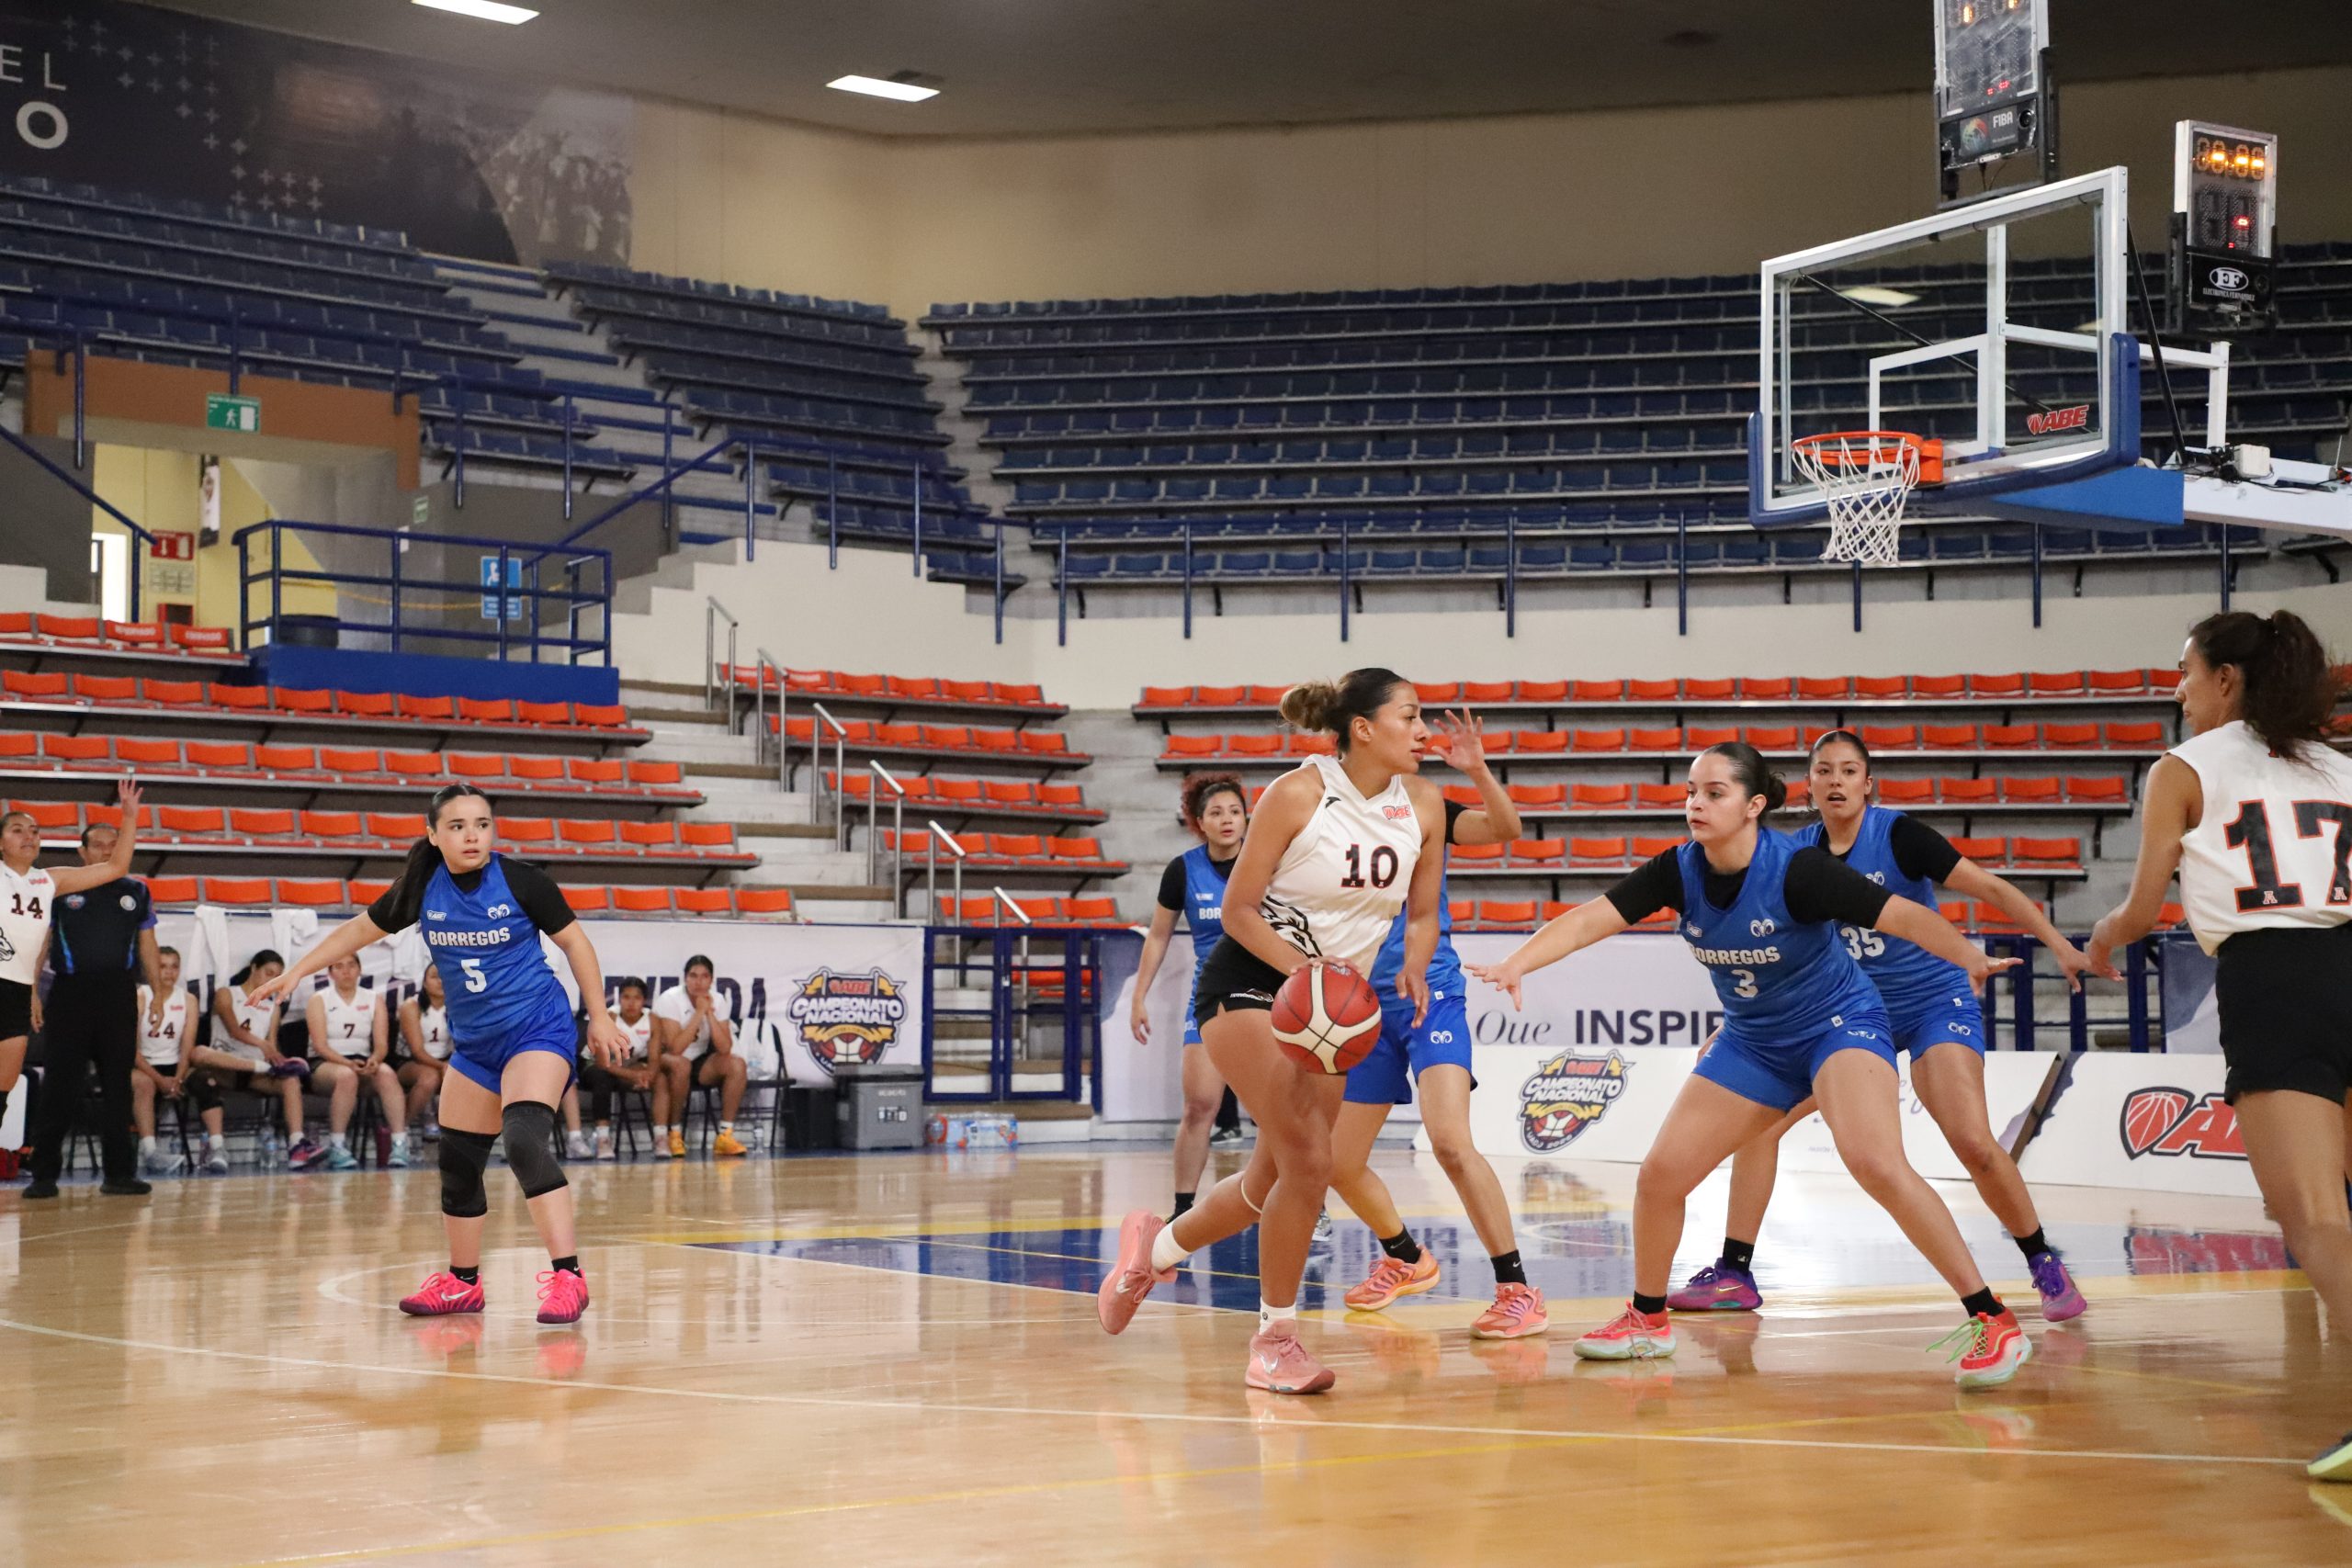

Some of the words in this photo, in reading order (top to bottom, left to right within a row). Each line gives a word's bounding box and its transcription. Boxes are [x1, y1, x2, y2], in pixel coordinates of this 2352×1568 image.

[16, 100, 69, 150] O
[1993, 111, 2014, 129] FIBA
[2039, 404, 2090, 434] ABE
[1340, 843, 1399, 889] 10
[2222, 798, 2352, 913] 17
[11, 893, 43, 919] 14
[428, 927, 511, 947] BORREGOS
[1840, 926, 1885, 960] 35
[461, 958, 487, 993] 5
[1731, 969, 1758, 998] 3
[791, 996, 904, 1019] CAMPEONATO
[804, 1010, 892, 1025] NACIONAL
[344, 1023, 356, 1038] 7
[1525, 1077, 1623, 1098] CAMPEONATO
[1531, 1090, 1607, 1103] NACIONAL
